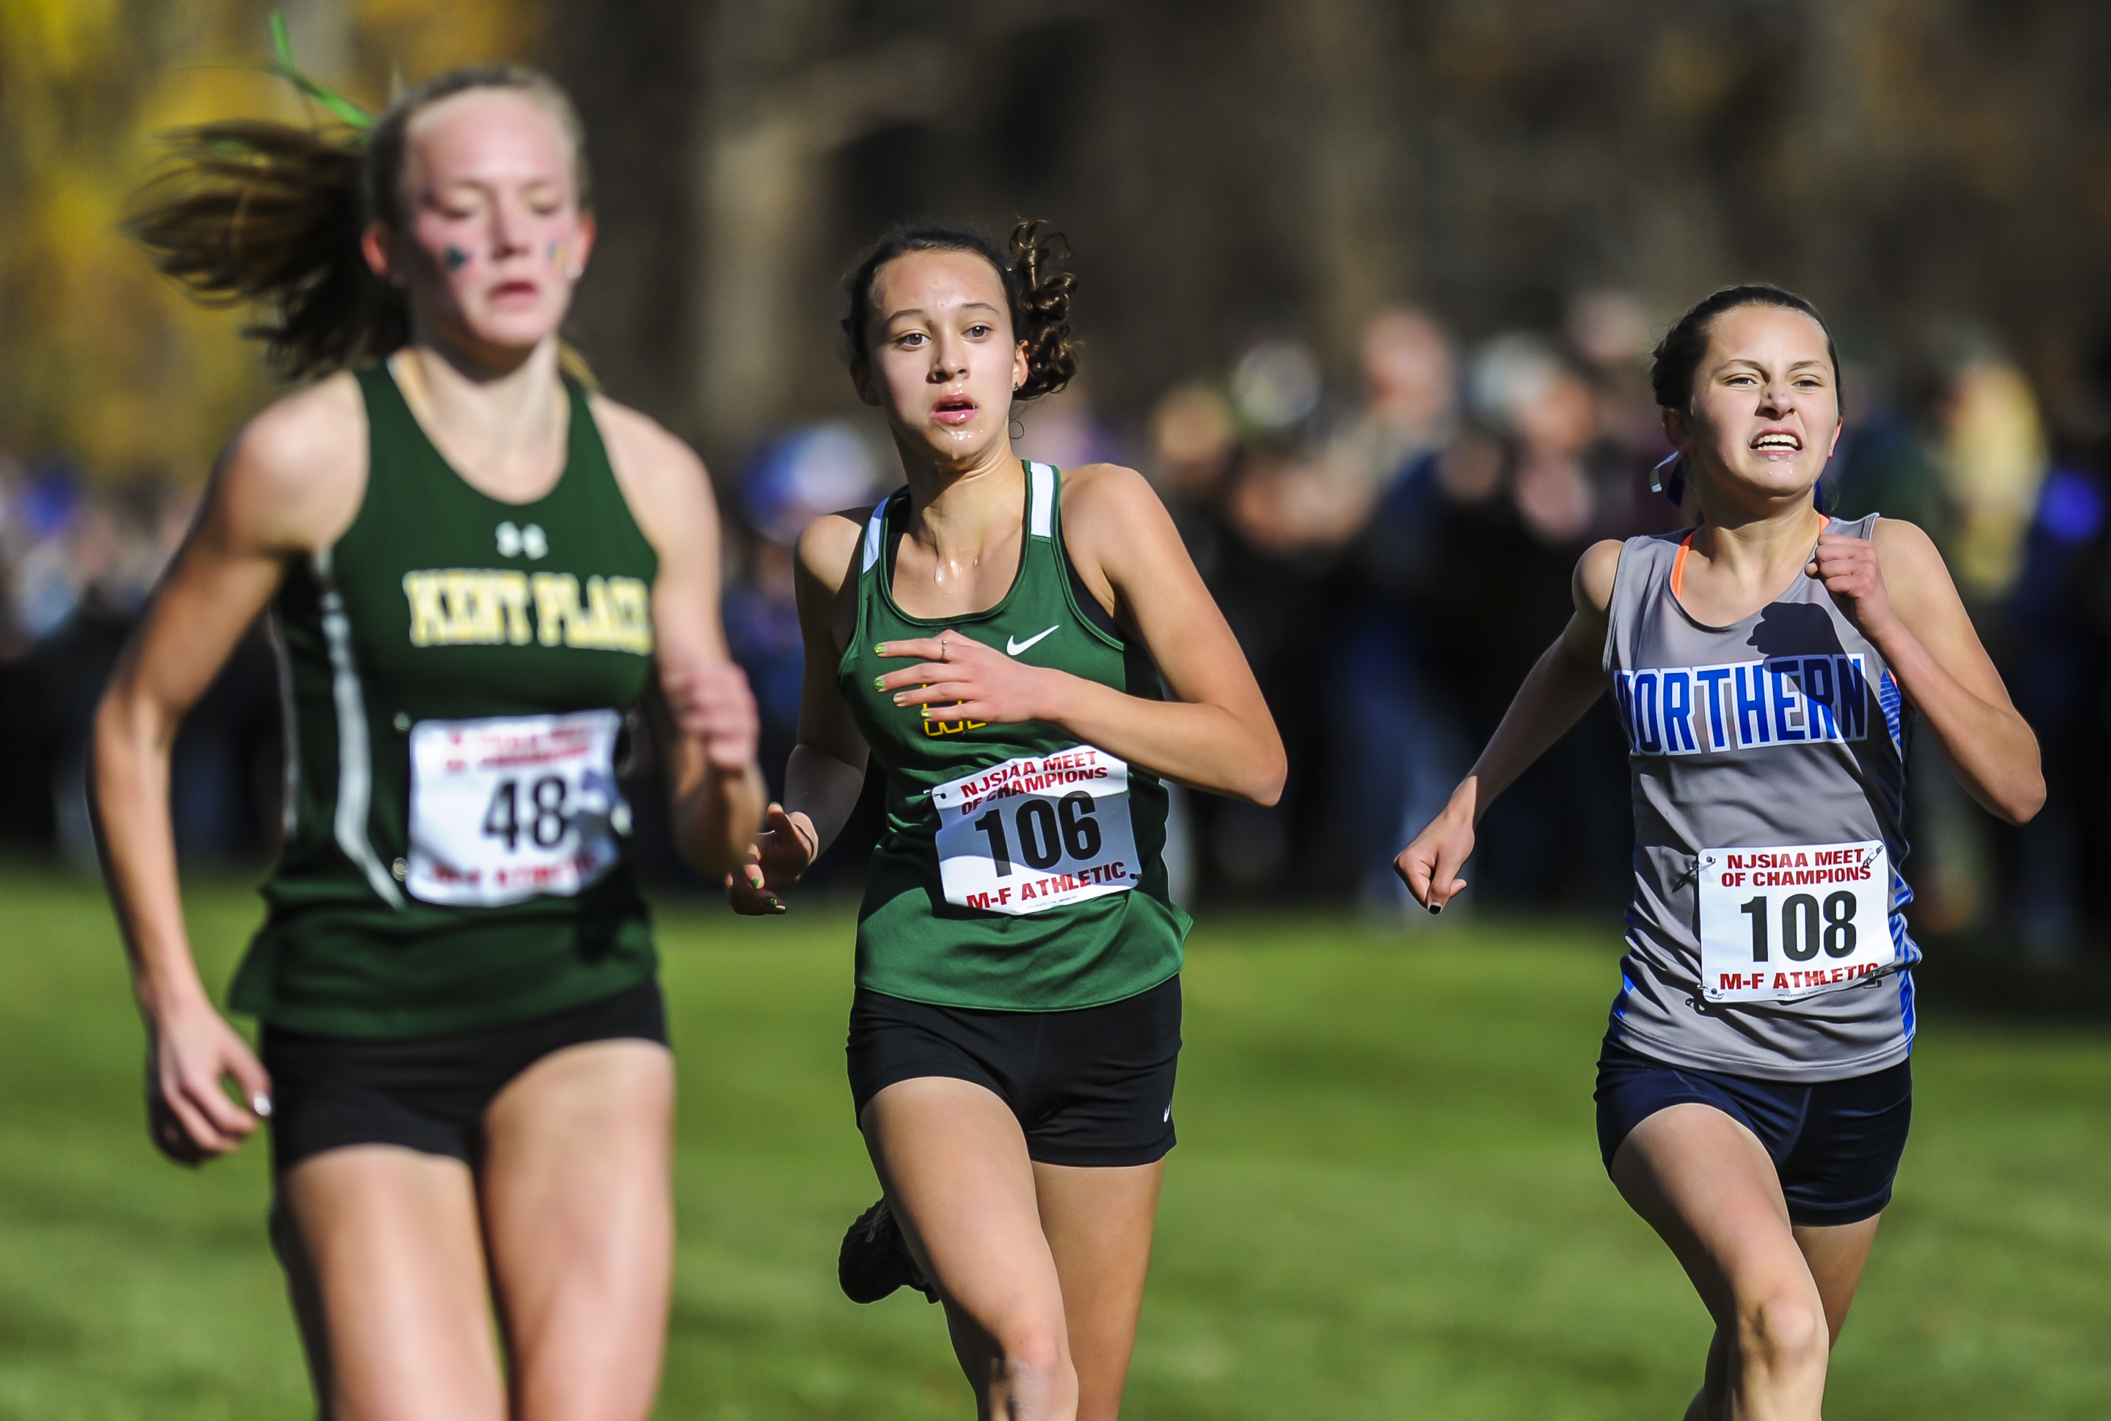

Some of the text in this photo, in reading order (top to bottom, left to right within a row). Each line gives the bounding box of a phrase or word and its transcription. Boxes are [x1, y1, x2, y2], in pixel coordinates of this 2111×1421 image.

[403, 569, 531, 647] KENT
[1614, 653, 1868, 756] NORTHERN
[961, 751, 1097, 798] NJSIAA MEET
[961, 767, 1108, 816] OF CHAMPIONS
[482, 775, 568, 854] 48
[974, 790, 1102, 878] 106
[1721, 866, 1871, 887] OF CHAMPIONS
[1727, 848, 1865, 869] NJSIAA MEET
[966, 888, 1012, 910] M-F
[1021, 861, 1127, 901] ATHLETIC
[1740, 890, 1857, 962] 108
[1720, 973, 1764, 990] M-F
